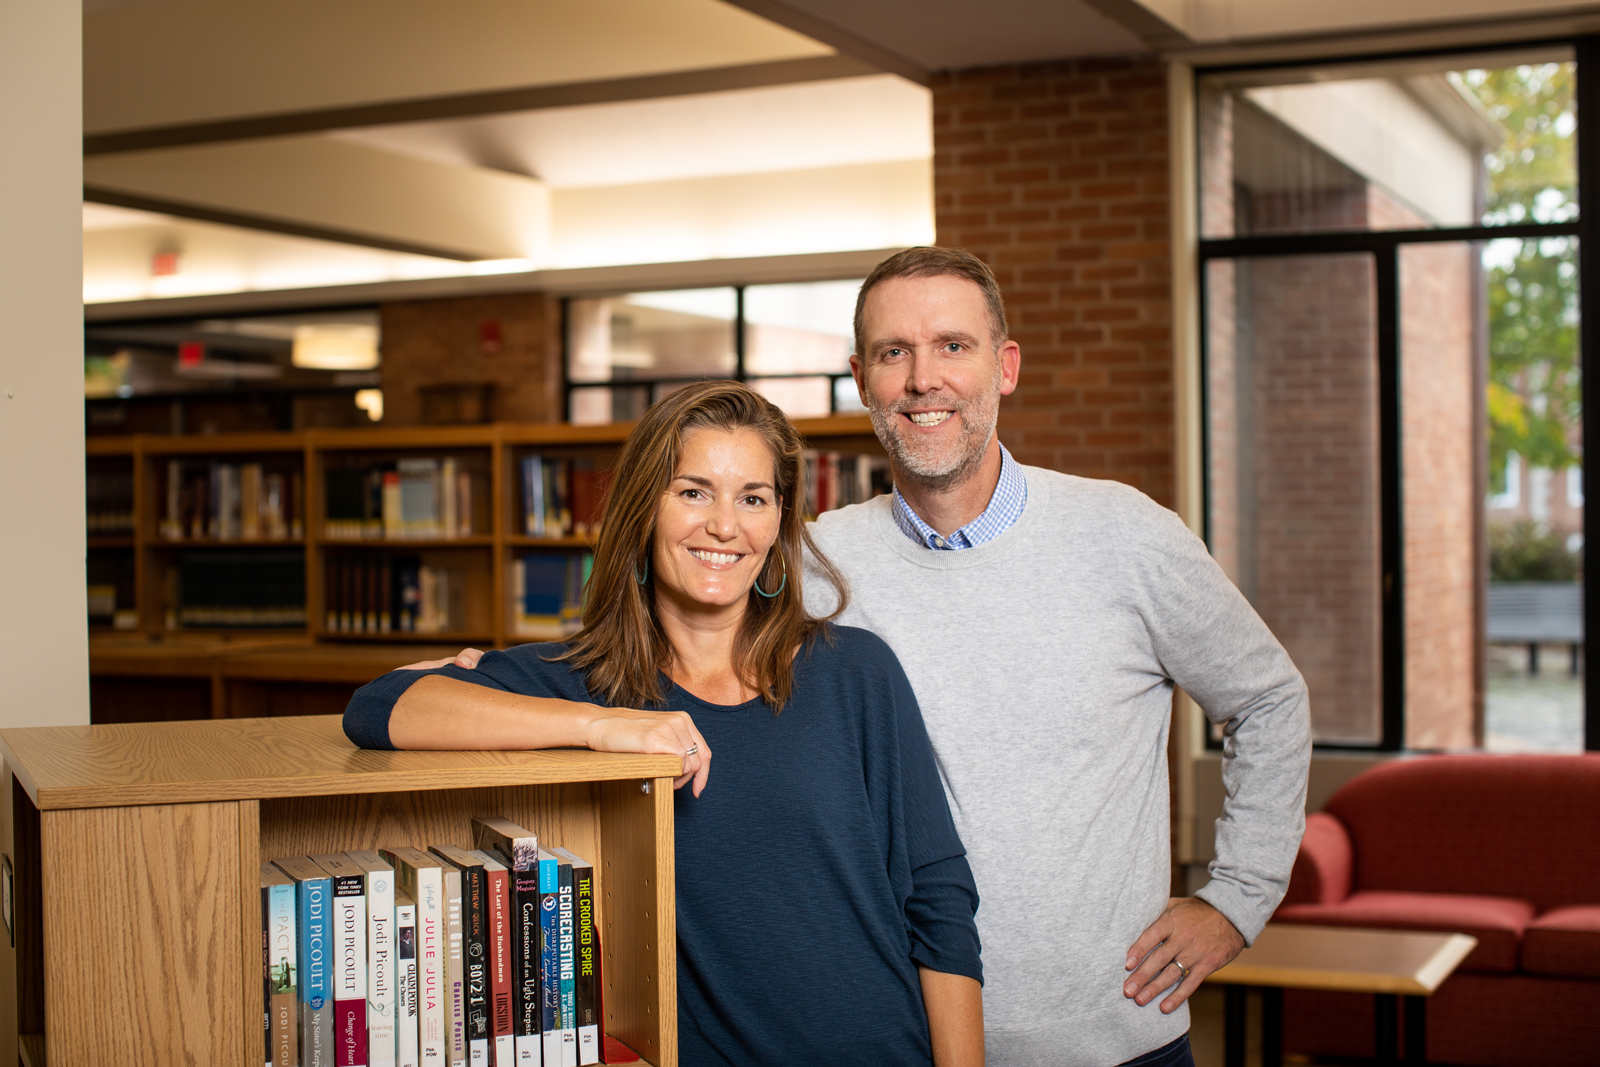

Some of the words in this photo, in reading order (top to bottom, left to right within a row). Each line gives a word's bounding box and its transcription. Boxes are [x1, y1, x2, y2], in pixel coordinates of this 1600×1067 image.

[580, 878, 590, 896] THE
[308, 884, 322, 920] JODI
[450, 897, 462, 926] TRUE
[497, 911, 502, 920] of
[342, 904, 355, 934] JODI
[373, 916, 386, 944] Jodi
[522, 903, 532, 960] Confessions
[560, 886, 573, 980] SCORECASTING
[580, 899, 592, 944] CROOKED
[278, 916, 290, 952] PACT
[426, 918, 436, 958] JULIE
[450, 932, 462, 960] GRIT
[310, 924, 324, 990] PICOULT
[344, 937, 356, 991] PICOULT
[581, 948, 592, 976] SPIRE
[376, 950, 388, 997] Picoult
[408, 964, 416, 990] CHAIM
[525, 969, 530, 978] an
[408, 990, 416, 1017] POTOK
[426, 968, 436, 1010] JULIA
[454, 982, 462, 1017] CHARLES
[523, 980, 534, 1000] Ugly
[312, 1014, 320, 1024] My
[345, 1012, 356, 1036] Change
[496, 992, 508, 1032] LOGSDON
[313, 1026, 322, 1050] Sister's
[346, 1037, 356, 1045] of
